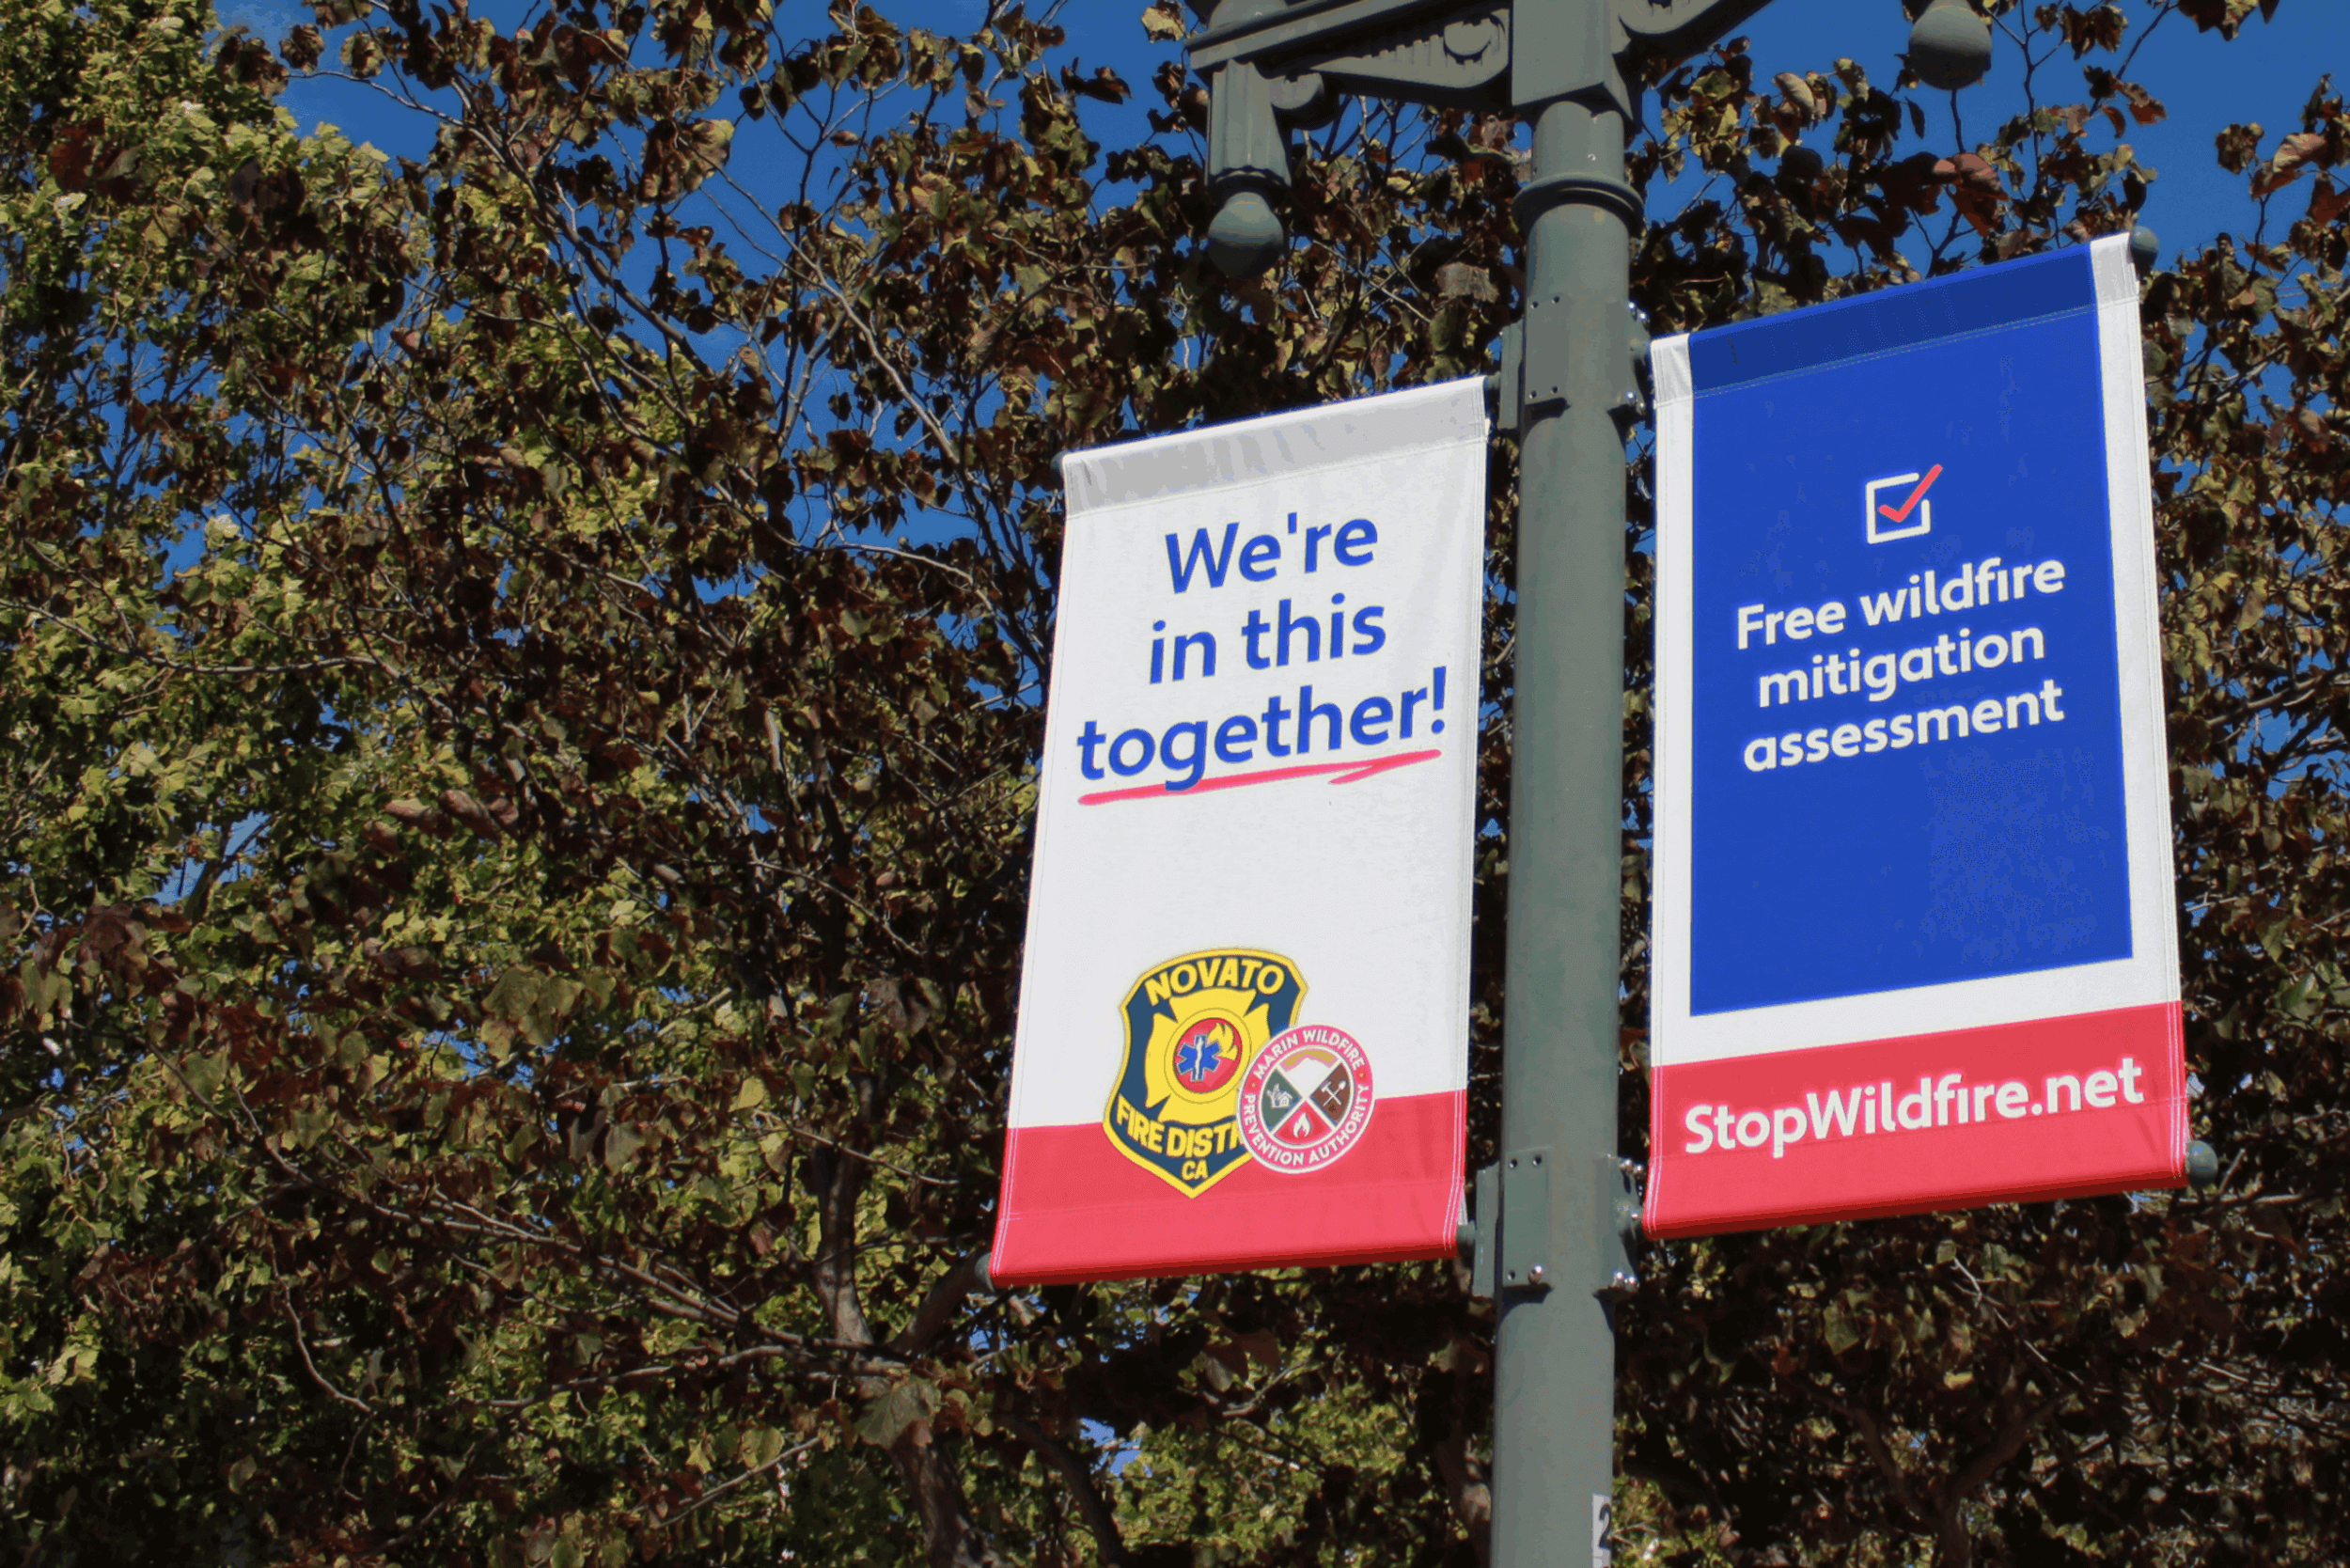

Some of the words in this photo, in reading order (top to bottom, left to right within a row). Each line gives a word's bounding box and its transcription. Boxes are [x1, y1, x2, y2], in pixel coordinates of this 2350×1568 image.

[1165, 512, 1378, 594] We're
[1150, 619, 1217, 684] in
[1242, 593, 1386, 670] this
[1737, 601, 1847, 650] Free
[1860, 557, 2066, 627] wildfire
[1759, 627, 2045, 707] mitigation
[1077, 666, 1447, 792] together!
[1743, 680, 2065, 773] assessment
[1143, 957, 1285, 1006] NOVATO
[1253, 1033, 1300, 1080] MARIN
[1302, 1028, 1366, 1071] WILDFIRE
[1116, 1093, 1166, 1153] FIRE
[1244, 1093, 1305, 1167] PREVENTION
[1308, 1083, 1370, 1165] AUTHORITY
[1684, 1058, 2145, 1159] StopWildfire.net
[1182, 1159, 1209, 1181] CA
